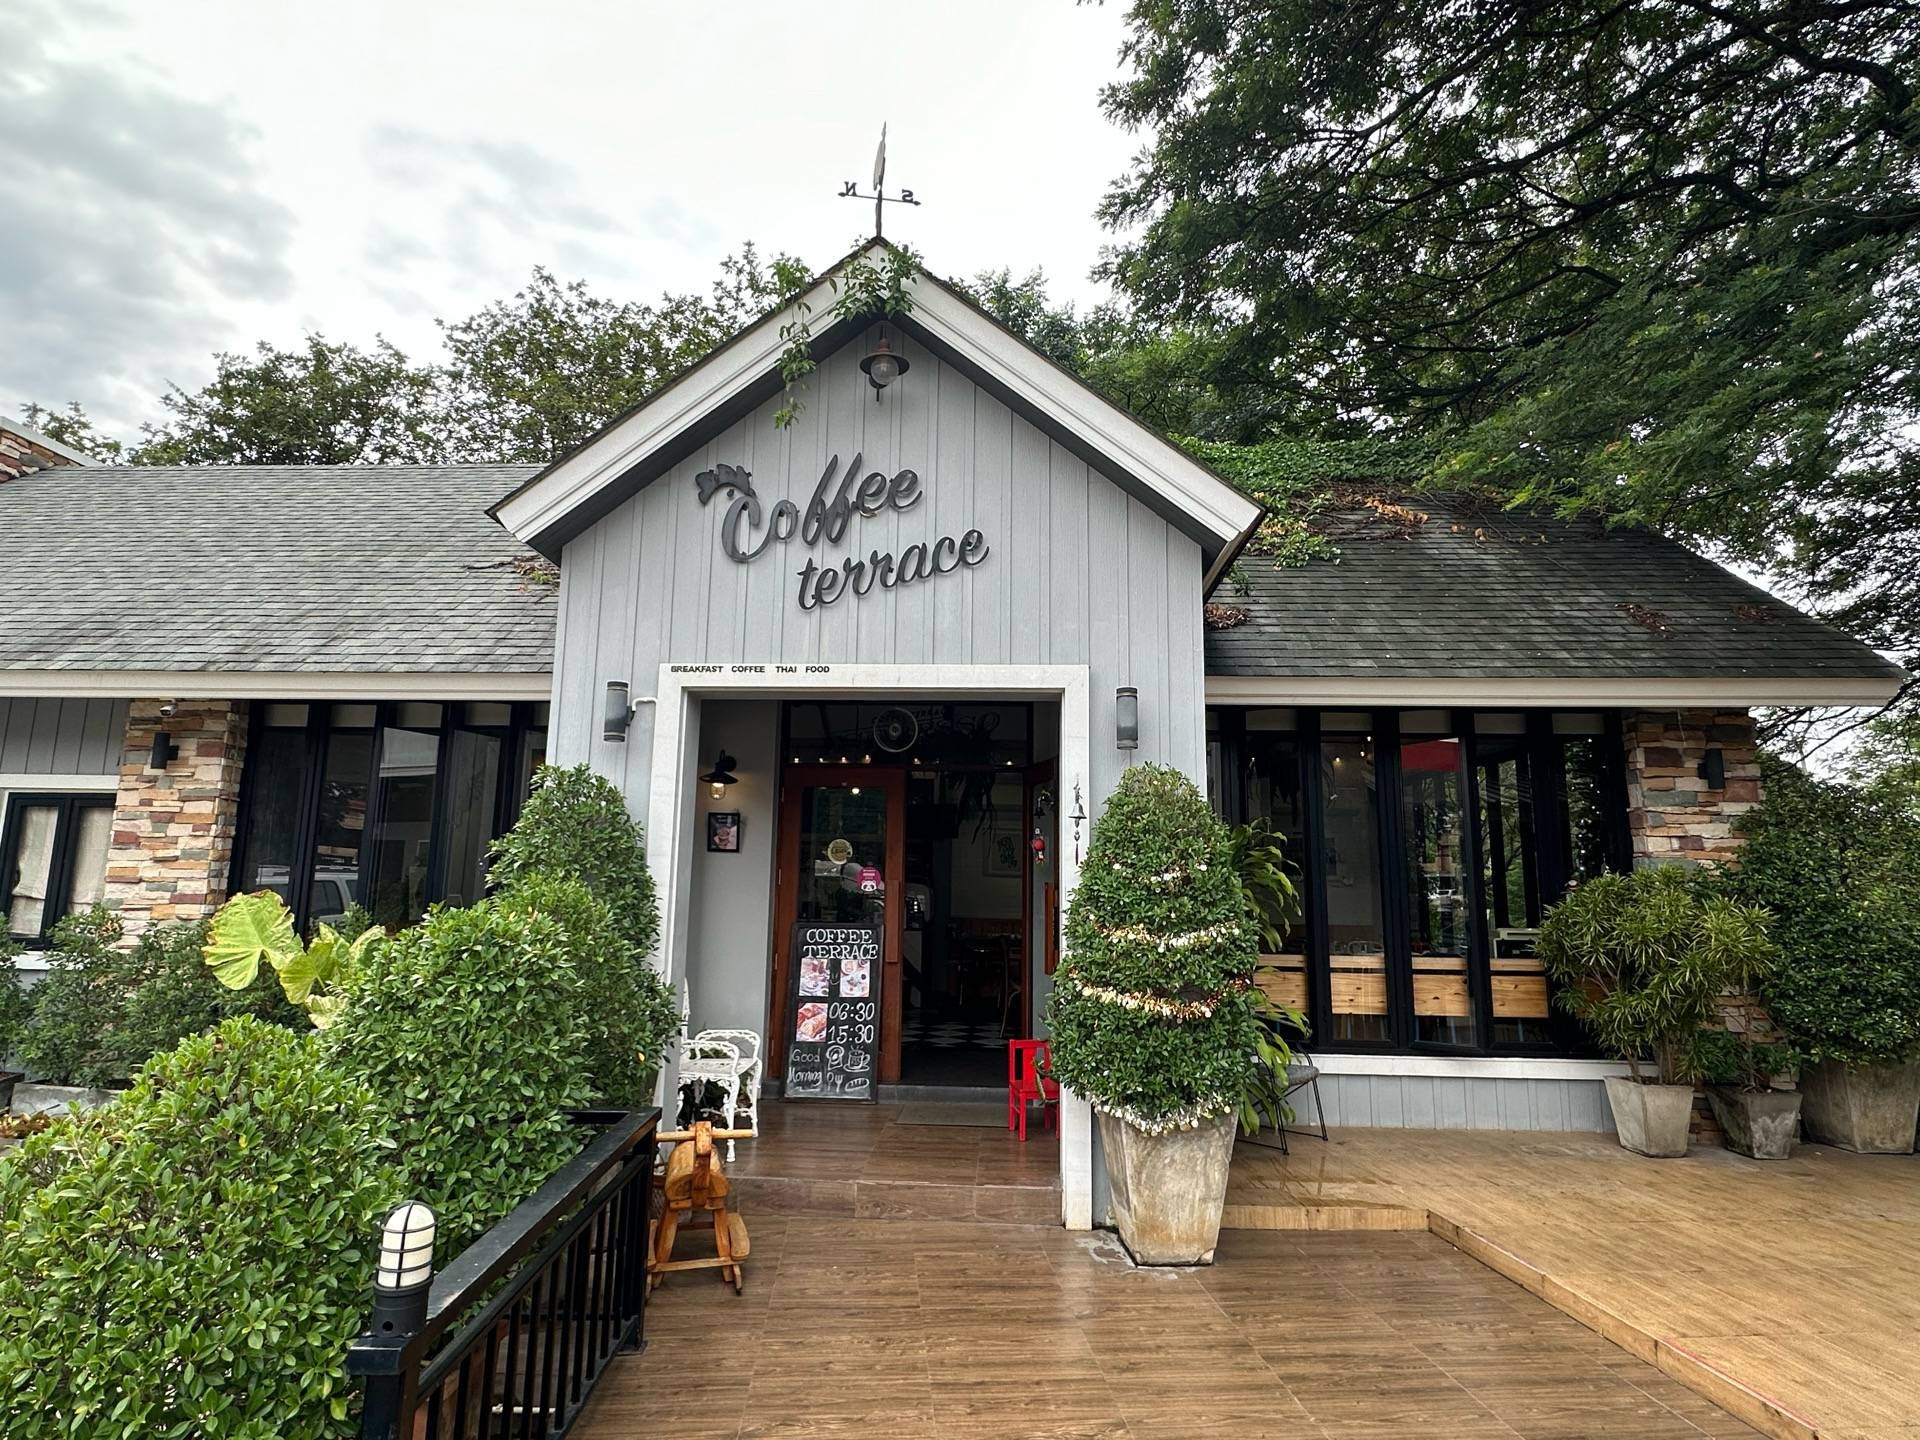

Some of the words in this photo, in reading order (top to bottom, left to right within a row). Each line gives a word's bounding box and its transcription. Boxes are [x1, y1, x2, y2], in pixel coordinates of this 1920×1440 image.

[722, 452, 923, 563] Coffee
[797, 529, 990, 611] terrace
[671, 665, 724, 673] BREAKFAST
[731, 665, 766, 673] COFFEE
[775, 665, 797, 673] THAI
[805, 665, 830, 673] FOOD
[806, 929, 873, 943] COFFEE
[803, 944, 878, 959] TERRACE
[829, 1002, 875, 1021] 06:30
[828, 1024, 874, 1044] 15:30
[791, 1049, 821, 1063] Good
[788, 1067, 822, 1085] Morning
